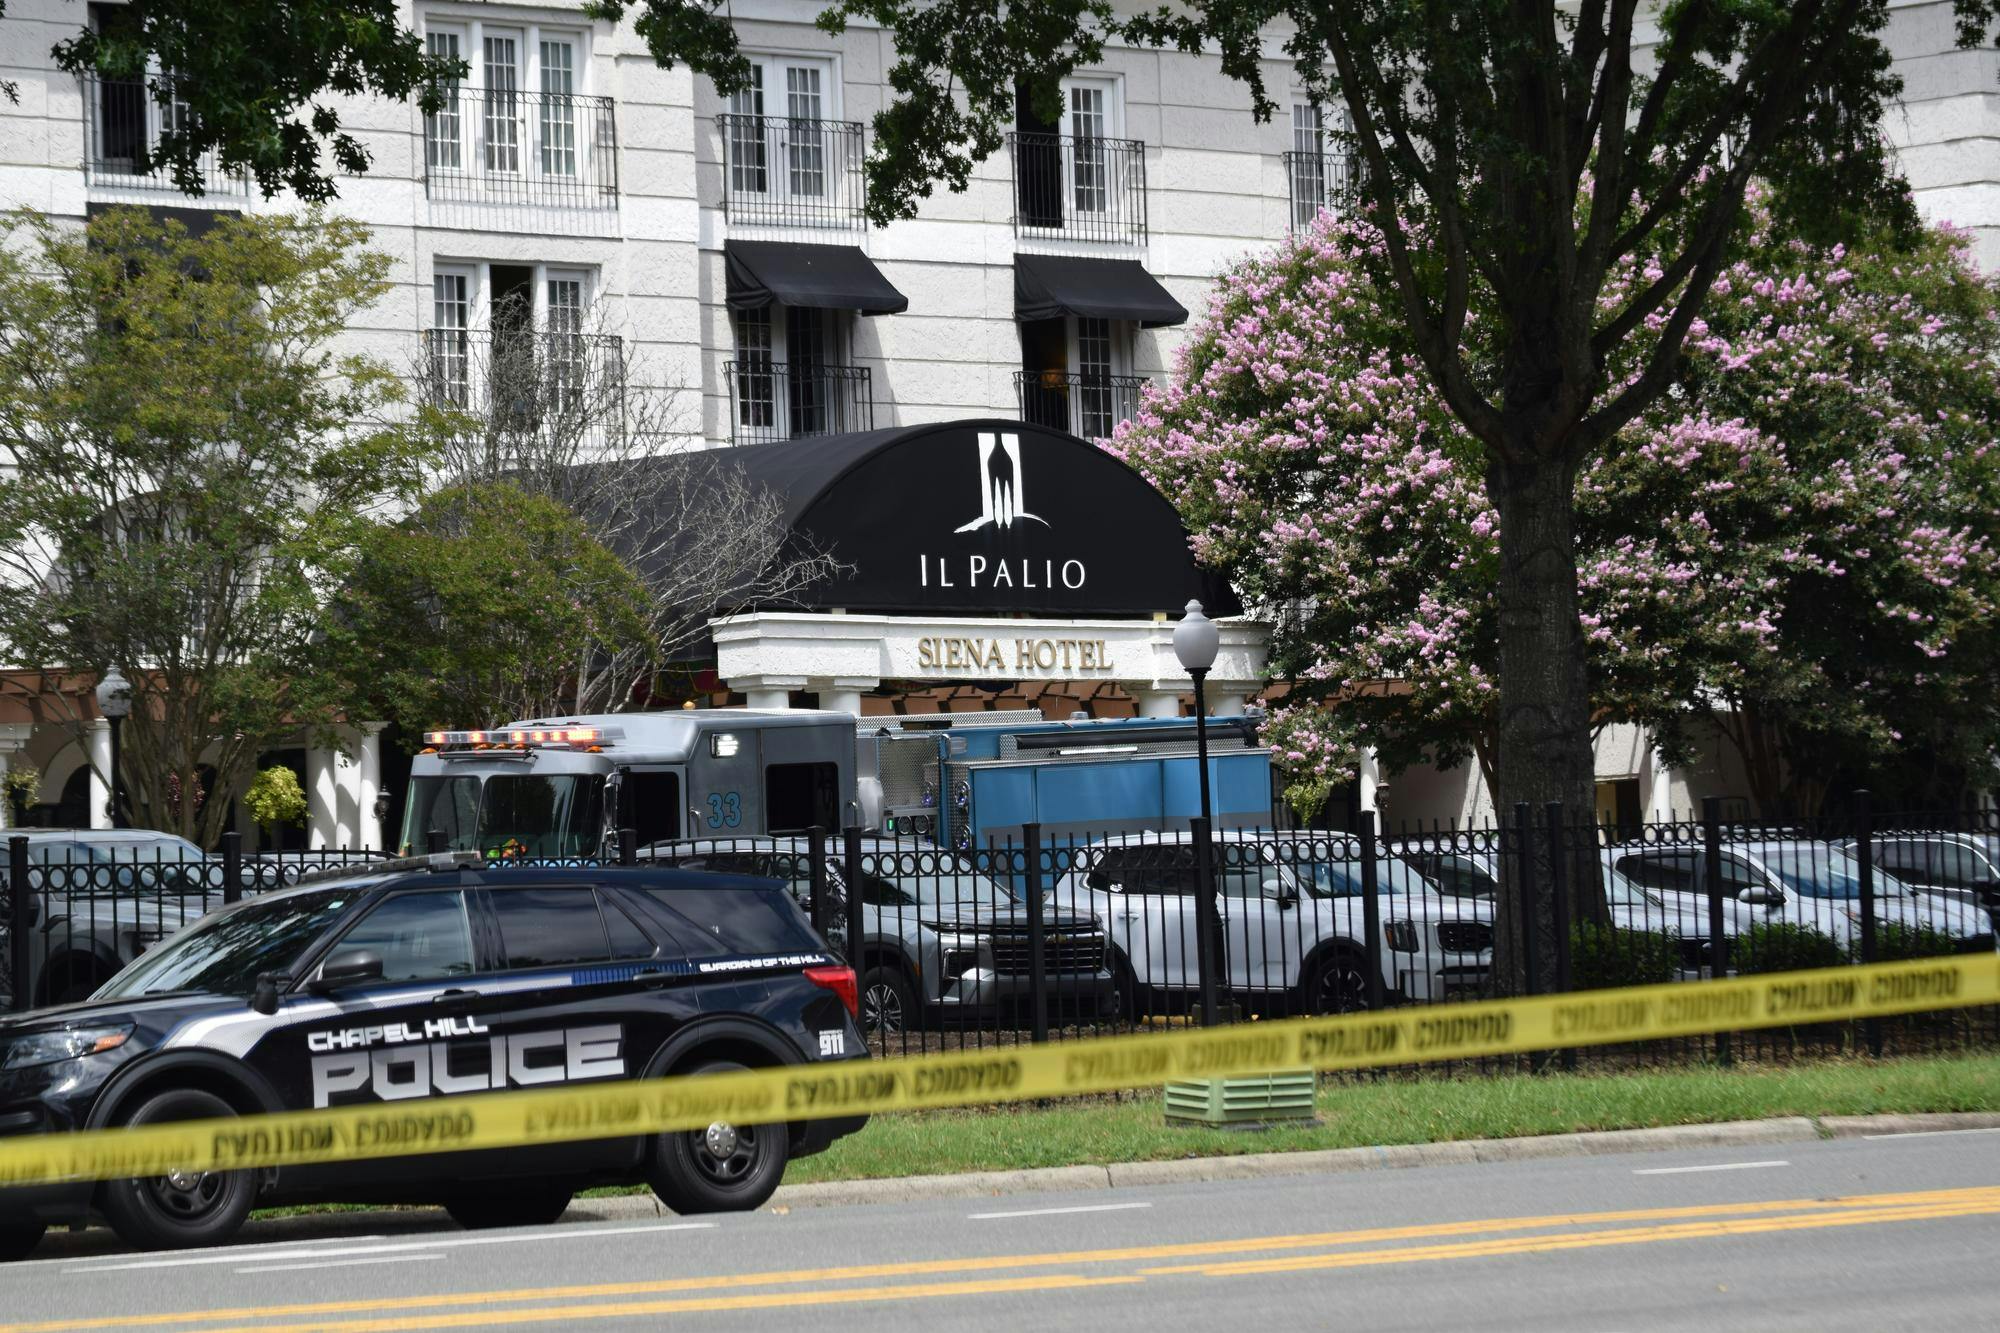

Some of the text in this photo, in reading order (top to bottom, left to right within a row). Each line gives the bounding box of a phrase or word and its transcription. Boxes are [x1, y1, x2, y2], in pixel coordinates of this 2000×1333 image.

[920, 554, 1086, 589] IL PALIO
[918, 637, 1114, 670] SIENA HOTEL
[706, 792, 742, 828] 33
[699, 954, 825, 973] GUARDIANS OF THE HILL
[308, 1015, 489, 1052] CHAPEL HILL
[820, 1034, 844, 1056] 911
[311, 1023, 625, 1109] POLICE
